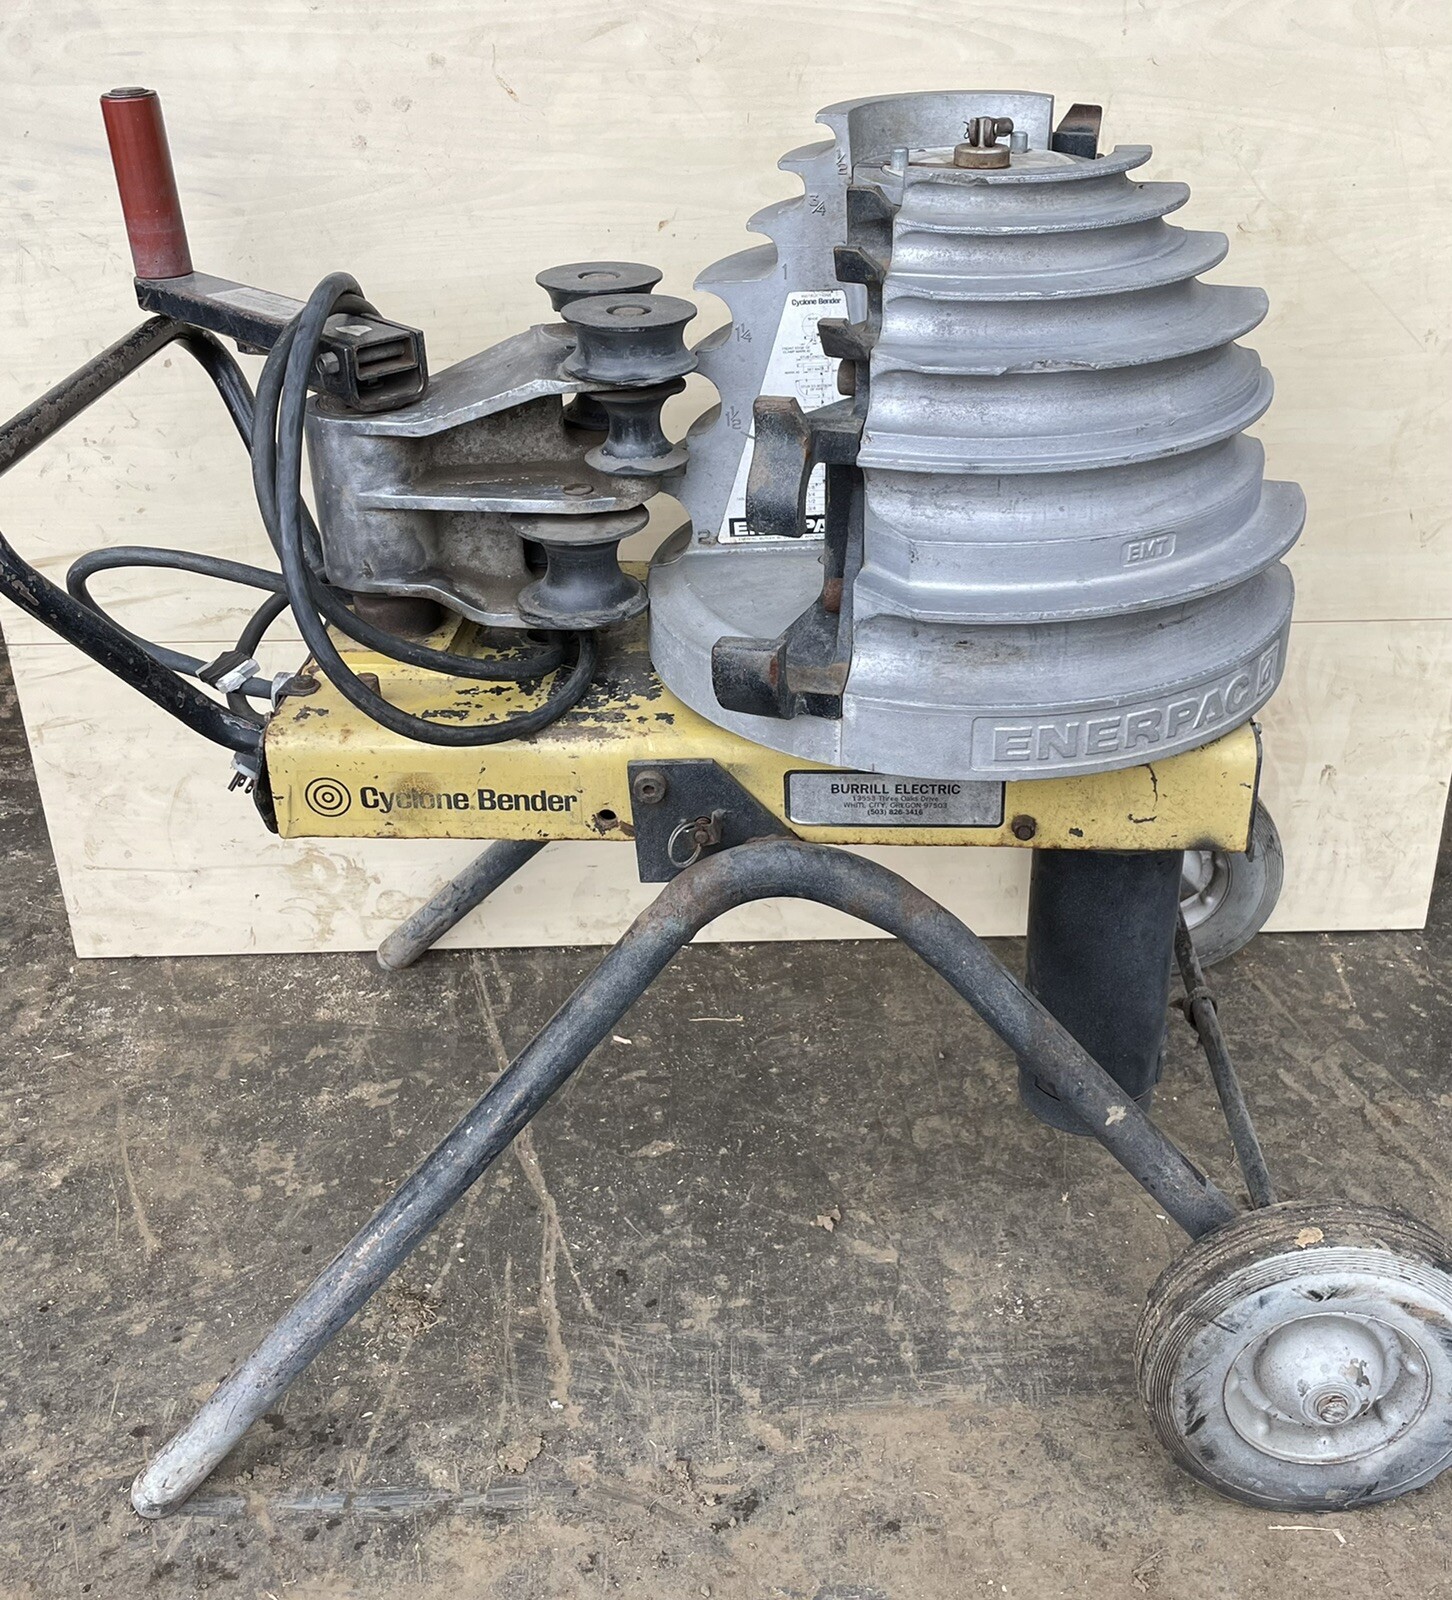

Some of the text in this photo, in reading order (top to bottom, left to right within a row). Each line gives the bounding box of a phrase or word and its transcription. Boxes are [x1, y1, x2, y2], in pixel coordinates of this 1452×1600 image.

[1126, 537, 1169, 562] EMT
[993, 675, 1250, 762] ENERPAC
[360, 786, 577, 813] Cyclone Bender
[831, 784, 961, 795] BURRILL ELECTRIC
